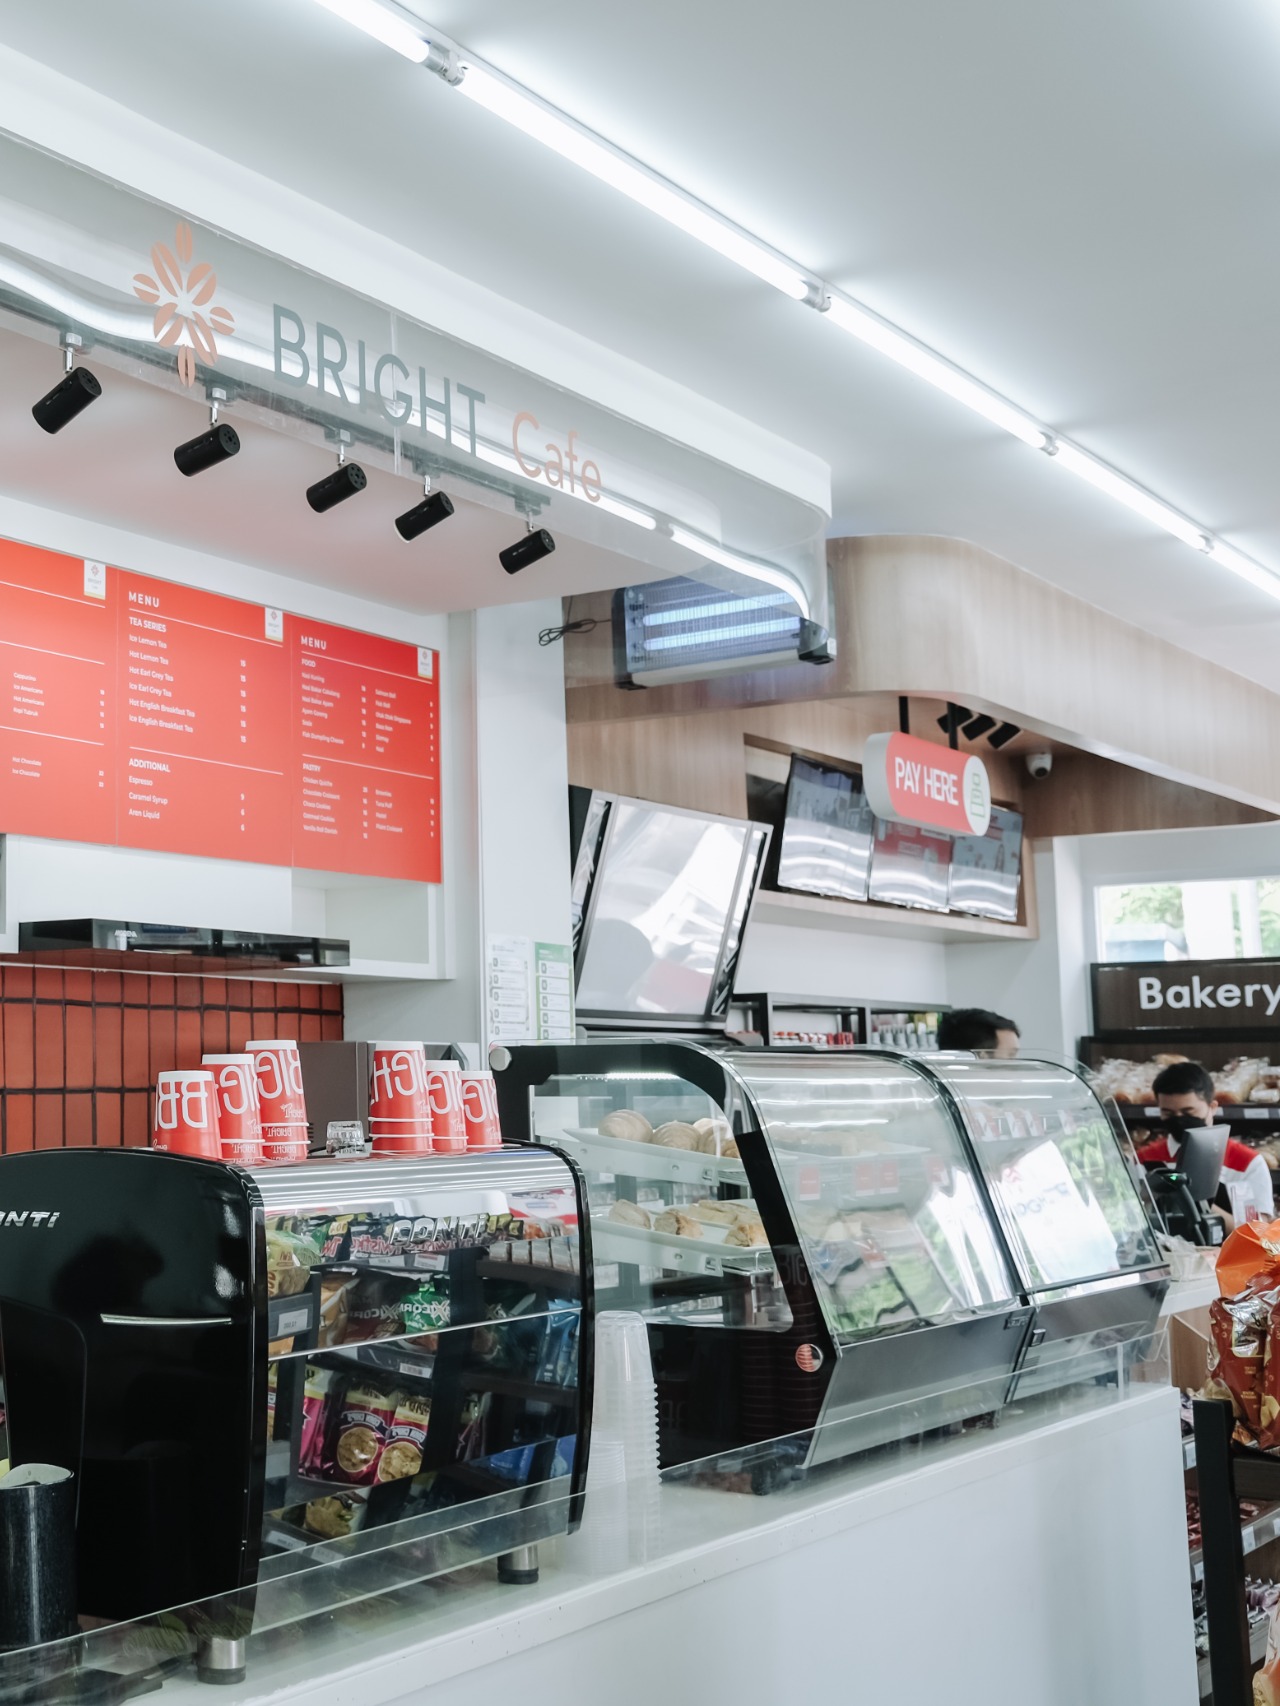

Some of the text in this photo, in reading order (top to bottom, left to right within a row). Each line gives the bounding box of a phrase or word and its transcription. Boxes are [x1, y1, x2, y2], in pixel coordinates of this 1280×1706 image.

[272, 302, 602, 503] BRIGHT Cafe
[128, 590, 160, 608] MENU
[129, 616, 167, 633] TEA SERIES
[129, 634, 167, 649] Ice Lemon Tea
[300, 635, 327, 650] MENU
[129, 650, 169, 665] Hot Lemon Tea
[129, 666, 140, 675] Hot
[164, 673, 174, 682] Tea
[129, 682, 138, 690] Ice
[138, 683, 150, 692] Earl
[129, 698, 140, 707] Hot
[129, 714, 138, 722] Ice
[137, 716, 159, 726] English
[128, 758, 171, 772] ADDITIONAL
[128, 775, 153, 786] Espresso
[895, 756, 959, 806] PAY HERE
[128, 792, 152, 802] Caramel
[1138, 975, 1280, 1016] Bakery
